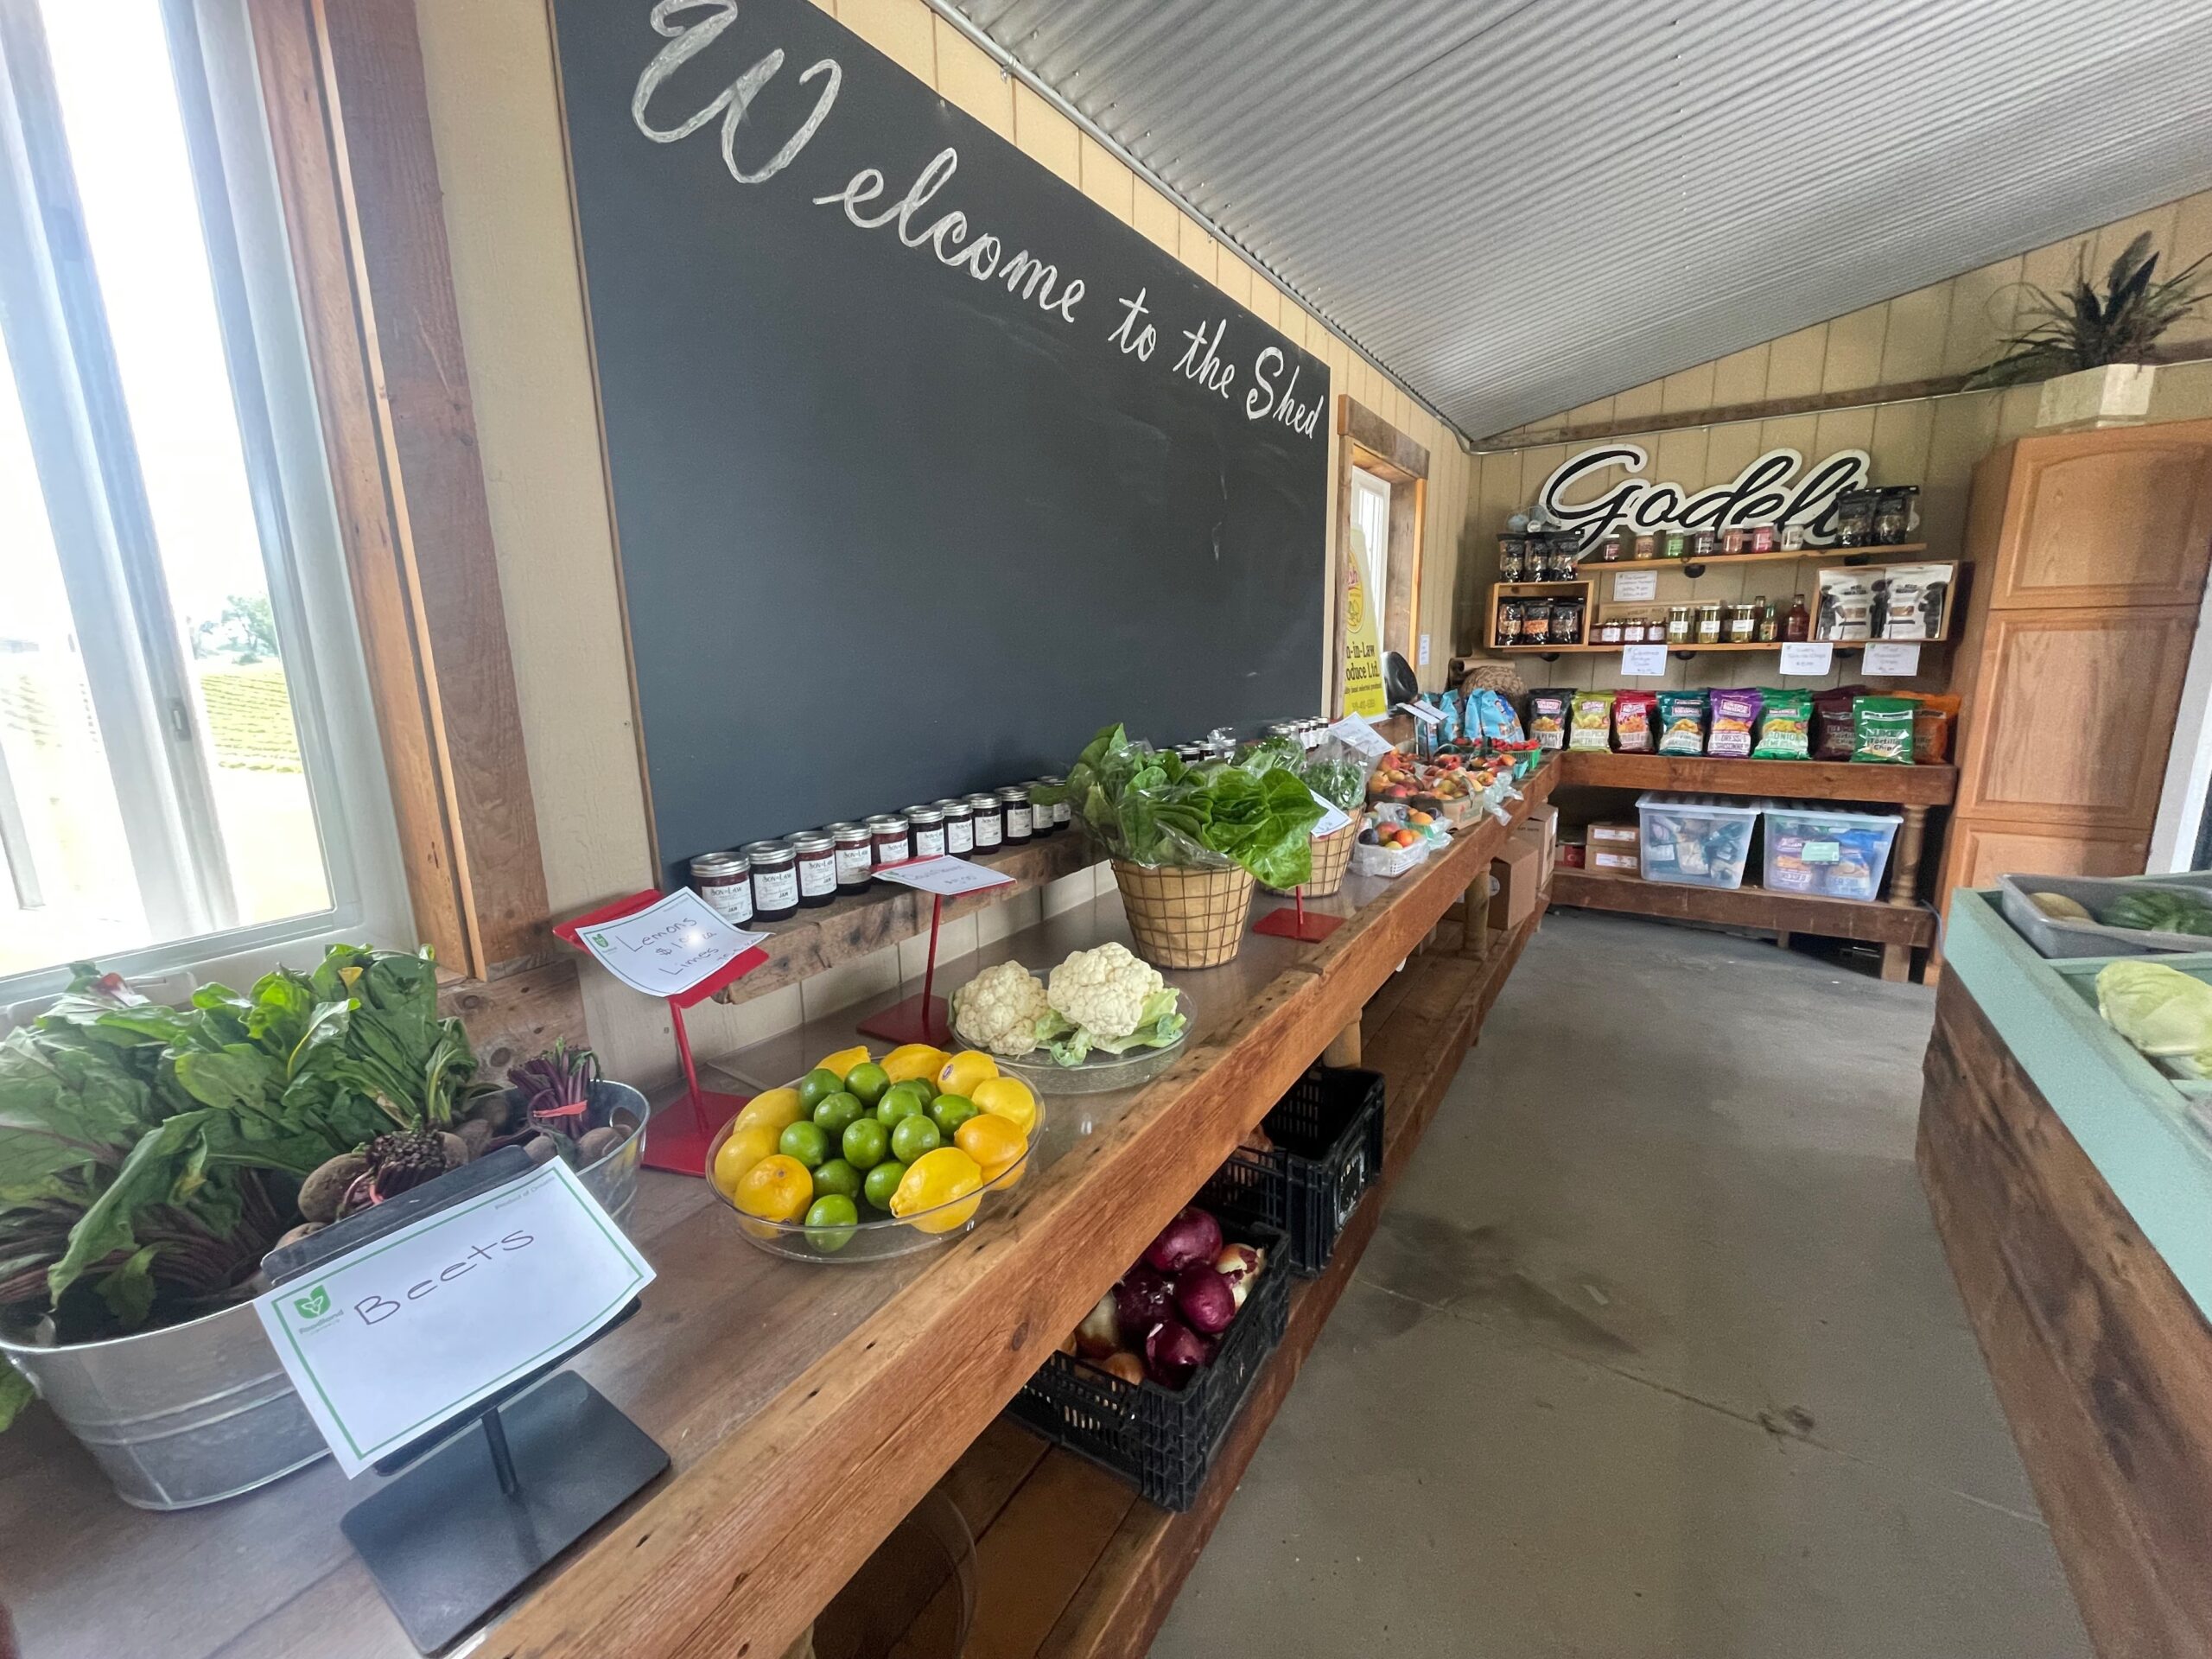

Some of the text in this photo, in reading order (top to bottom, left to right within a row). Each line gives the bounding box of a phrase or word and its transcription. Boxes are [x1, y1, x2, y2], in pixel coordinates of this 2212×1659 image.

[631, 0, 1322, 441] Welcome to the Shed
[615, 917, 697, 951] Lemons
[658, 947, 719, 975] Limes
[353, 1230, 534, 1325] Beets
